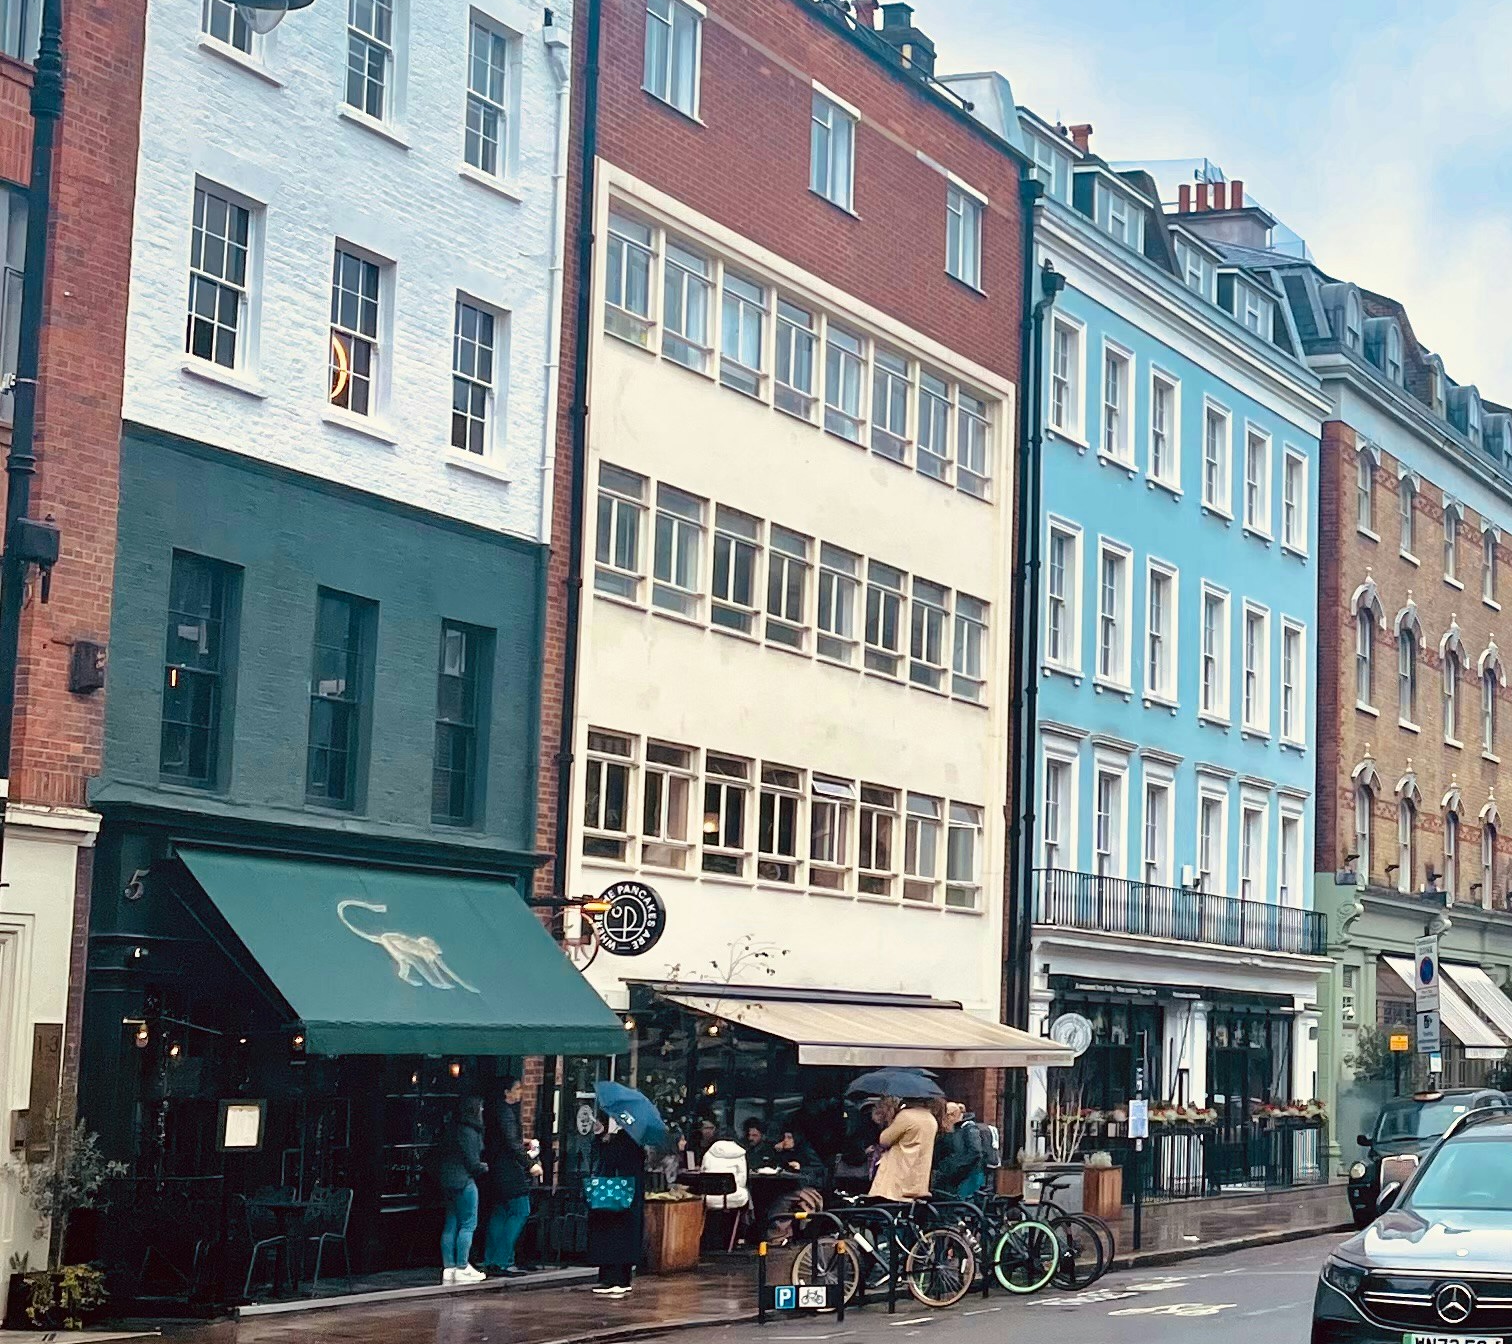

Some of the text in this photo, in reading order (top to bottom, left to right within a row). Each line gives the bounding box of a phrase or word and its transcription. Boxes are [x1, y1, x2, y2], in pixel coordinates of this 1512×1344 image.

[124, 869, 150, 900] 5
[616, 884, 657, 928] PANCAKES
[630, 928, 650, 950] ARE
[779, 1288, 792, 1307] P
